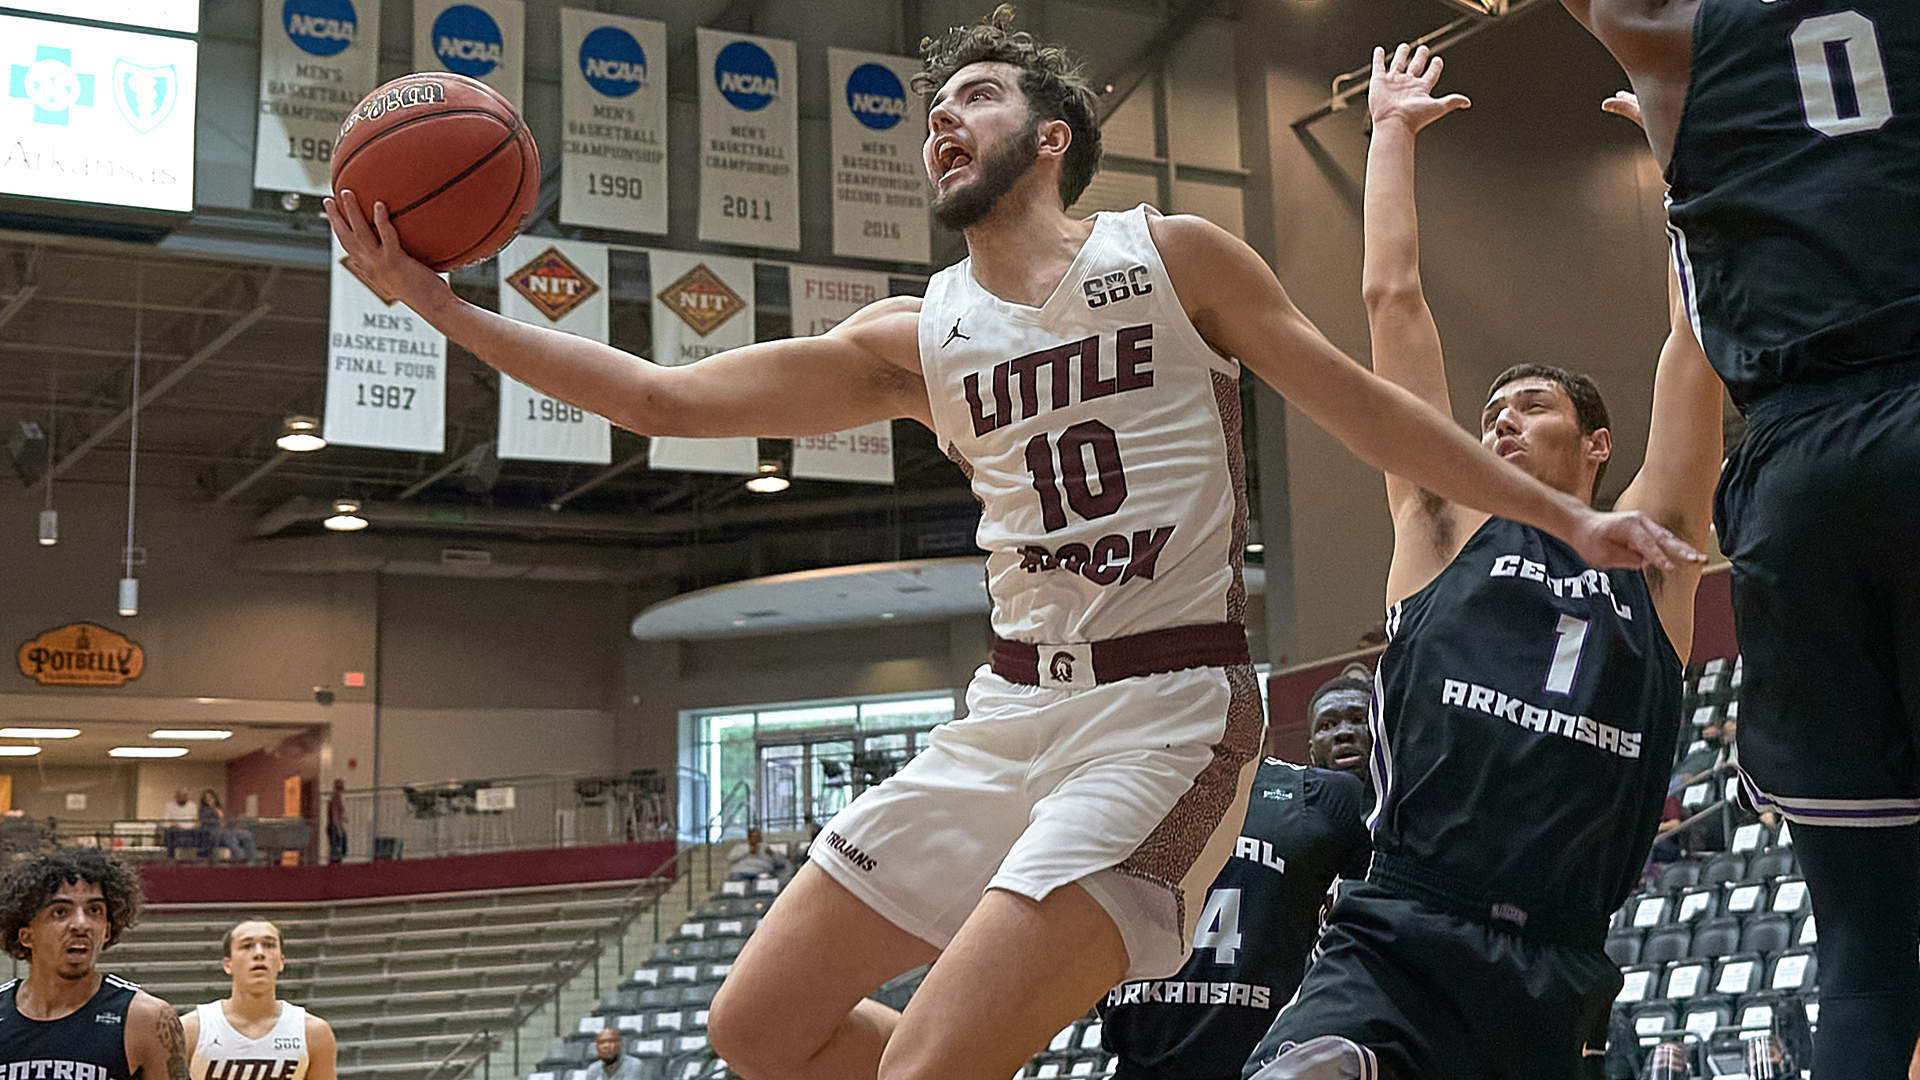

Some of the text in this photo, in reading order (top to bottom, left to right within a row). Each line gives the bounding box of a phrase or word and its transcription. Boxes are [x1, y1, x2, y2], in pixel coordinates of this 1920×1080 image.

[289, 13, 354, 41] NCAA
[438, 36, 500, 63] NCAA
[586, 58, 645, 83] NCAA
[1788, 8, 1894, 138] 0
[720, 72, 778, 97] NCAA
[593, 105, 635, 123] MEN'S
[852, 92, 908, 117] NCAA
[568, 121, 660, 145] BASKETBALL
[288, 136, 330, 162] 198
[564, 140, 664, 165] CHAMPIONSHIP
[711, 139, 785, 160] BASKETBALL
[588, 172, 642, 200] 1990
[723, 194, 772, 222] 2011
[528, 274, 581, 296] NIT
[805, 279, 876, 305] FISHER
[1083, 265, 1152, 309] SBC
[680, 291, 729, 311] NIT
[363, 313, 413, 332] MEN'S
[332, 332, 439, 358] BASKETBALL
[335, 356, 436, 381] FINAL FOUR
[963, 323, 1154, 438] LITTLE
[356, 383, 416, 410] 1987
[1025, 419, 1128, 533] 10
[1543, 613, 1592, 697] 1
[1442, 678, 1642, 759] ARKANSAS
[826, 831, 877, 871] TROJANS
[1193, 888, 1243, 965] 4
[1106, 981, 1271, 1009] ARKANSAS
[204, 1059, 299, 1080] LITTLE
